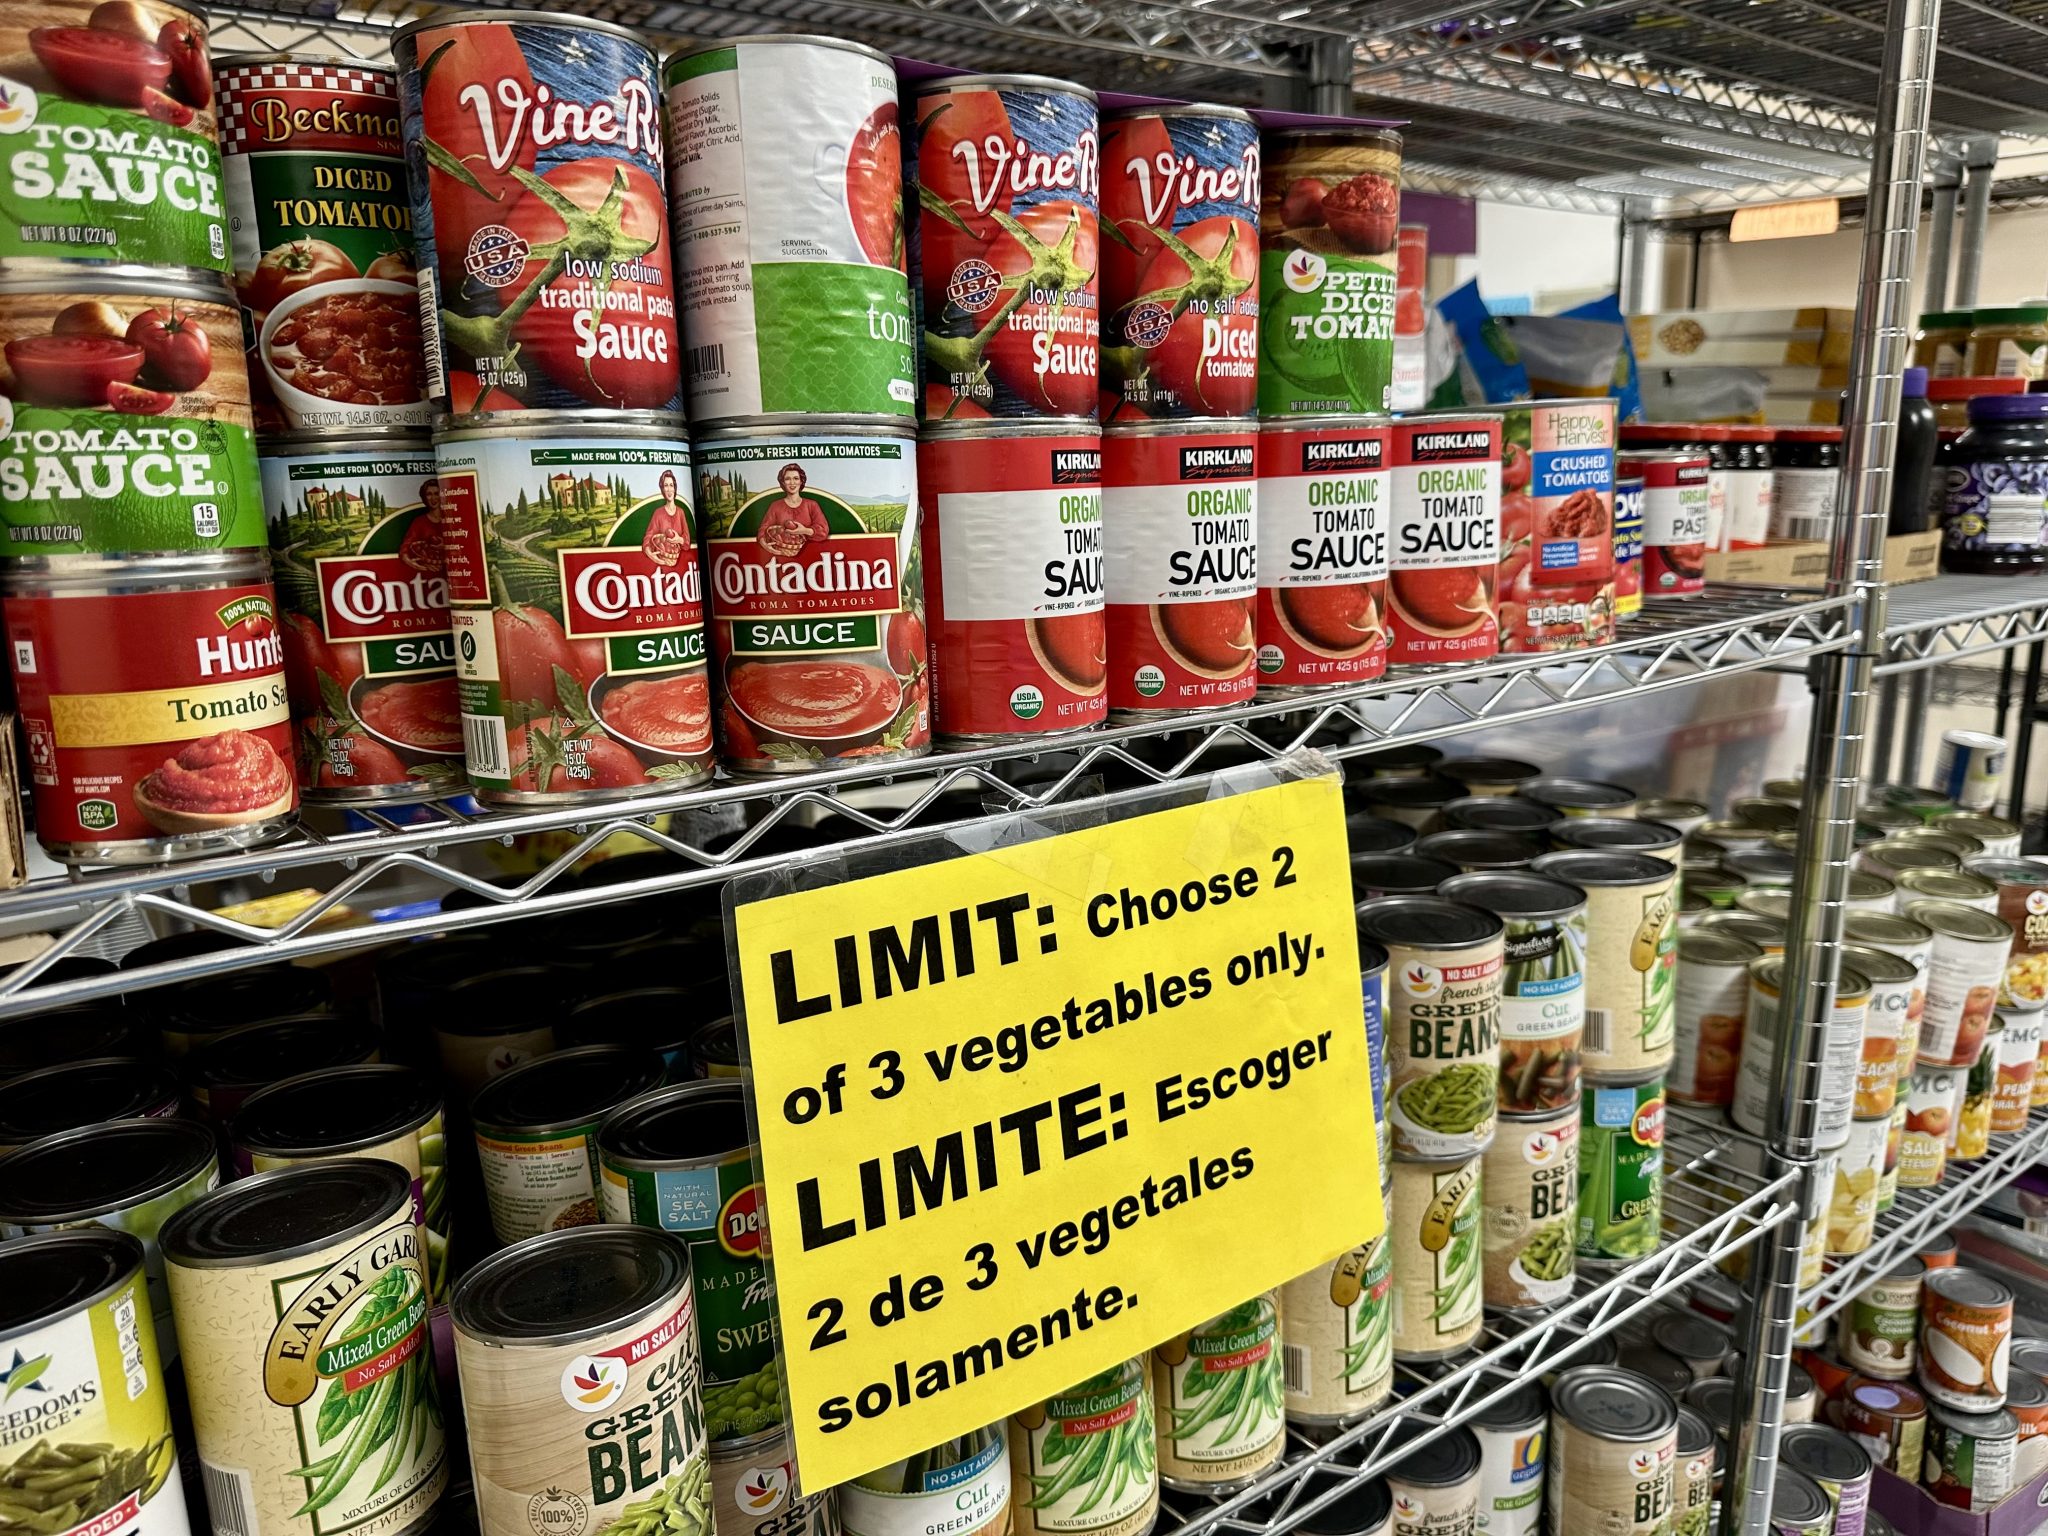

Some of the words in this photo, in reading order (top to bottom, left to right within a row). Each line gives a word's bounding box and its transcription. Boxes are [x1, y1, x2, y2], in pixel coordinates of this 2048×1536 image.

[701, 92, 720, 103] Solids
[461, 78, 619, 171] Vine
[708, 123, 737, 135] Ascorbic
[26, 124, 209, 169] TOMATO
[706, 137, 723, 147] Citric
[10, 151, 220, 218] SAUCE
[314, 166, 391, 192] DICED
[952, 134, 1075, 214] Vine
[1125, 149, 1241, 225] Vine
[725, 200, 745, 208] Saints,
[468, 244, 525, 269] USA
[564, 251, 603, 278] low
[611, 257, 663, 286] sodium
[731, 260, 745, 269] Add
[716, 273, 740, 282] stirring
[731, 282, 752, 292] soup,
[951, 276, 998, 298] USA
[539, 281, 643, 313] traditional
[1030, 282, 1058, 305] low
[1063, 286, 1096, 309] sodium
[1214, 294, 1236, 315] salt
[1321, 293, 1395, 315] DICE
[1008, 308, 1084, 334] traditional
[572, 310, 668, 364] Sauce
[1203, 316, 1257, 358] Diced
[475, 358, 489, 371] NET
[491, 357, 504, 371] WT
[1032, 332, 1096, 377] Sauce
[477, 374, 486, 386] 15
[488, 372, 499, 385] OZ
[501, 371, 528, 388] (425g)
[1206, 359, 1255, 378] tomatoes
[347, 411, 371, 424] 14.5
[1549, 414, 1596, 432] Happy
[8, 428, 197, 453] TOMATO
[1417, 432, 1489, 450] KIRKLAND
[1556, 430, 1607, 446] Harvest
[619, 450, 648, 463] 100%
[737, 447, 765, 459] 100%
[767, 446, 798, 458] FRESH
[801, 446, 830, 457] ROMA
[833, 445, 881, 456] TOMATOES
[1185, 449, 1253, 466] KIRKLAND
[1308, 442, 1380, 459] KIRKLAND
[372, 463, 404, 473] 100%
[1551, 455, 1605, 471] CRUSHED
[1, 454, 215, 501] SAUCE
[1418, 468, 1487, 493] ORGANIC
[1542, 470, 1610, 487] TOMATOES
[1186, 488, 1252, 517] ORGANIC
[1309, 479, 1378, 507] ORGANIC
[1422, 495, 1483, 519] TOMATO
[1191, 518, 1249, 547] TOMATO
[1313, 508, 1374, 534] TOMATO
[1400, 519, 1494, 553] SAUCE
[1290, 532, 1384, 570] SAUCE
[1168, 544, 1256, 586] SAUCE
[714, 551, 894, 605] Contadina
[332, 569, 450, 625] Conta
[575, 561, 702, 620] Contadi
[224, 604, 245, 621] 100%
[750, 600, 789, 610] ROMA
[798, 596, 875, 608] TOMATOES
[636, 614, 672, 624] ROMA
[751, 621, 856, 646] SAUCE
[637, 633, 705, 662] SAUCE
[1261, 650, 1278, 658] USDA
[1140, 672, 1159, 680] USDA
[1336, 661, 1351, 671] 425
[1359, 658, 1369, 669] (15
[168, 691, 267, 723] Tomato
[1016, 693, 1037, 701] USDA
[770, 893, 1057, 1024] LIMIT:
[1088, 859, 1258, 939] Choose
[1272, 847, 1297, 888] 2
[1446, 969, 1459, 981] NO
[1461, 966, 1481, 979] SALT
[1440, 982, 1483, 1004] french
[1539, 983, 1559, 992] SALT
[1541, 1003, 1569, 1019] Cut
[783, 1064, 846, 1125] of
[869, 1051, 904, 1100] 3
[925, 968, 1211, 1083] vegetables
[1227, 931, 1325, 986] only.
[1517, 1022, 1554, 1032] GREEN
[798, 1084, 1128, 1252] LIMITE:
[1157, 1032, 1332, 1123] Escoger
[664, 1190, 712, 1199] NATURAL
[672, 1201, 707, 1211] SEA
[669, 1210, 712, 1222] SALT
[808, 1298, 846, 1351] 2
[870, 1268, 943, 1328] de
[966, 1243, 997, 1290] 3
[1015, 1147, 1253, 1270] vegetales
[121, 1305, 131, 1322] 20
[279, 1260, 364, 1363] EARLY
[328, 1334, 373, 1373] Mixed
[376, 1317, 408, 1349] Green
[408, 1296, 426, 1326] Beans
[631, 1339, 650, 1360] NO
[651, 1320, 675, 1349] SALT
[1194, 1336, 1226, 1354] Mixed
[1228, 1331, 1256, 1350] Green
[358, 1367, 376, 1383] No
[378, 1353, 396, 1371] Salt
[398, 1332, 421, 1360] Added
[646, 1321, 695, 1392] cut
[818, 1285, 1139, 1434] solamente.
[1213, 1359, 1227, 1368] No
[1246, 1348, 1266, 1364] Added
[1052, 1398, 1087, 1417] Mixed
[1090, 1391, 1119, 1411] Green
[1121, 1378, 1142, 1401] Beans
[1073, 1421, 1088, 1432] No
[1089, 1415, 1106, 1429] Salt
[1108, 1407, 1132, 1425] Added
[931, 1473, 949, 1486] NO
[950, 1464, 974, 1480] SALT
[342, 1494, 388, 1521] MIXTURE
[403, 1472, 419, 1489] CUT
[955, 1481, 990, 1511] Cut
[541, 1508, 573, 1524] 100%
[926, 1512, 973, 1535] GREEN
[977, 1485, 1006, 1516] BEANS
